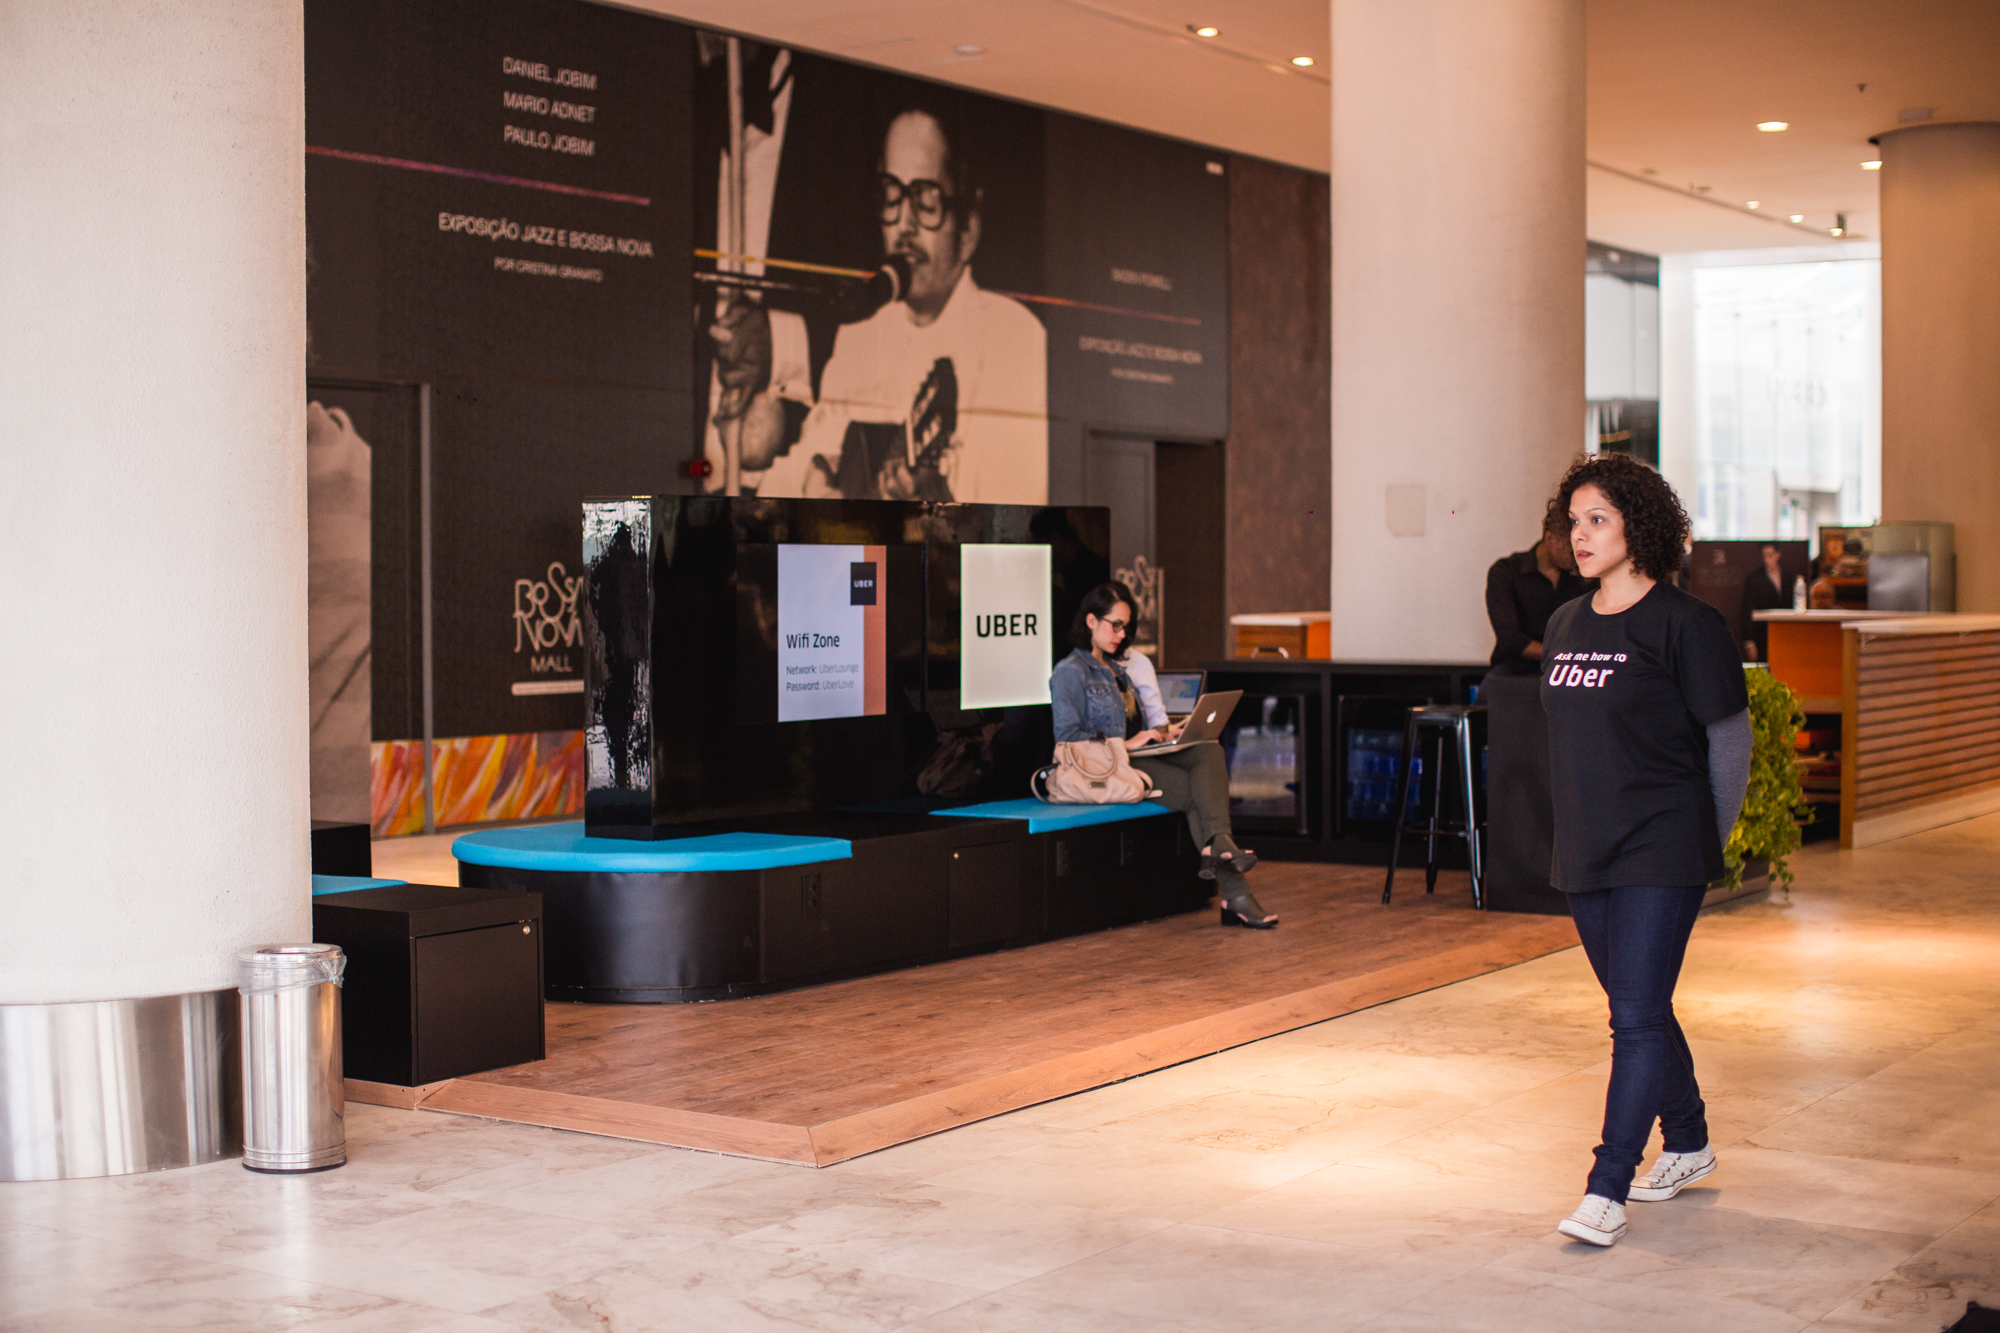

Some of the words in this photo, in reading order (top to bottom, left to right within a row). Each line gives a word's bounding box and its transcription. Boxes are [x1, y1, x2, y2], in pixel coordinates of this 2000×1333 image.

[503, 56, 552, 83] DANIEL
[553, 67, 598, 90] JOBIM
[503, 91, 550, 115] MARIO
[503, 124, 551, 149] PAULO
[551, 134, 595, 156] JOBIM
[438, 212, 520, 241] EXPOSIÇÃO
[521, 225, 556, 246] JAZZ
[557, 229, 568, 247] E
[569, 230, 615, 252] BOSSA
[616, 237, 653, 257] NOVA
[853, 579, 874, 589] UBER
[976, 614, 1037, 638] UBER
[786, 633, 810, 649] Wifi
[813, 633, 840, 648] Zone
[531, 655, 573, 673] MALL
[1553, 652, 1574, 661] Ask
[1572, 652, 1590, 661] me
[1590, 651, 1613, 661] how
[1613, 653, 1628, 663] to
[822, 680, 855, 690] UberLove
[1548, 664, 1615, 688] Uber
